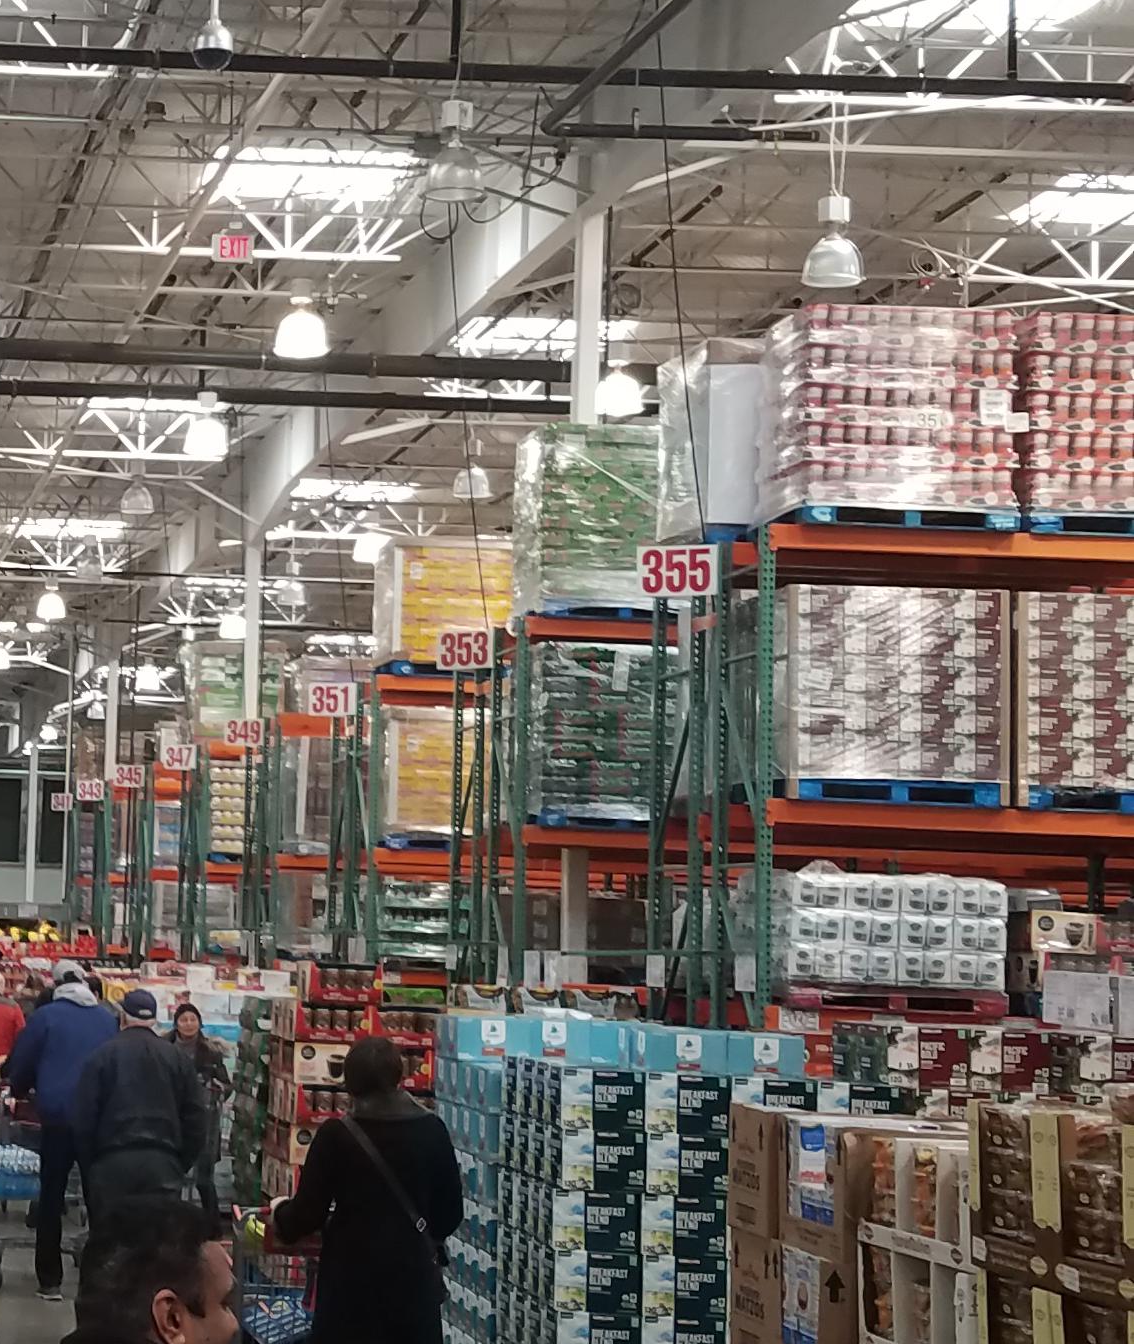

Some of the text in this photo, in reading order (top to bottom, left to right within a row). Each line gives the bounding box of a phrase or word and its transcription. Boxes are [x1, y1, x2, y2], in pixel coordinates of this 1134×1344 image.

[220, 237, 249, 258] EXIT
[641, 548, 712, 593] 355
[440, 631, 488, 667] 353
[312, 686, 350, 713] 351
[227, 720, 261, 744] 349
[166, 747, 193, 767] 347
[116, 766, 142, 787] 345
[79, 782, 102, 800] 343
[53, 794, 70, 809] 341
[594, 1085, 634, 1096] BREAKFAST
[679, 1090, 719, 1100] BREAKFAST
[595, 1094, 617, 1103] BLEND
[679, 1099, 702, 1108] BLEND
[596, 1146, 635, 1156] BREAKFAST
[681, 1150, 720, 1161] BREAKFAST
[596, 1154, 618, 1164] BLEND
[681, 1159, 703, 1168] BLEND
[587, 1206, 625, 1216] BREAKFAST
[587, 1215, 609, 1225] BLEND
[676, 1212, 715, 1222] BREAKFAST
[676, 1221, 698, 1230] BLEND
[589, 1268, 628, 1279] BREAKFAST
[677, 1273, 716, 1283] BREAKFAST
[589, 1276, 611, 1286] BLEND
[677, 1281, 699, 1291] BLEND
[592, 1329, 630, 1340] BREAKFAST
[676, 1333, 715, 1344] BREAKFAST
